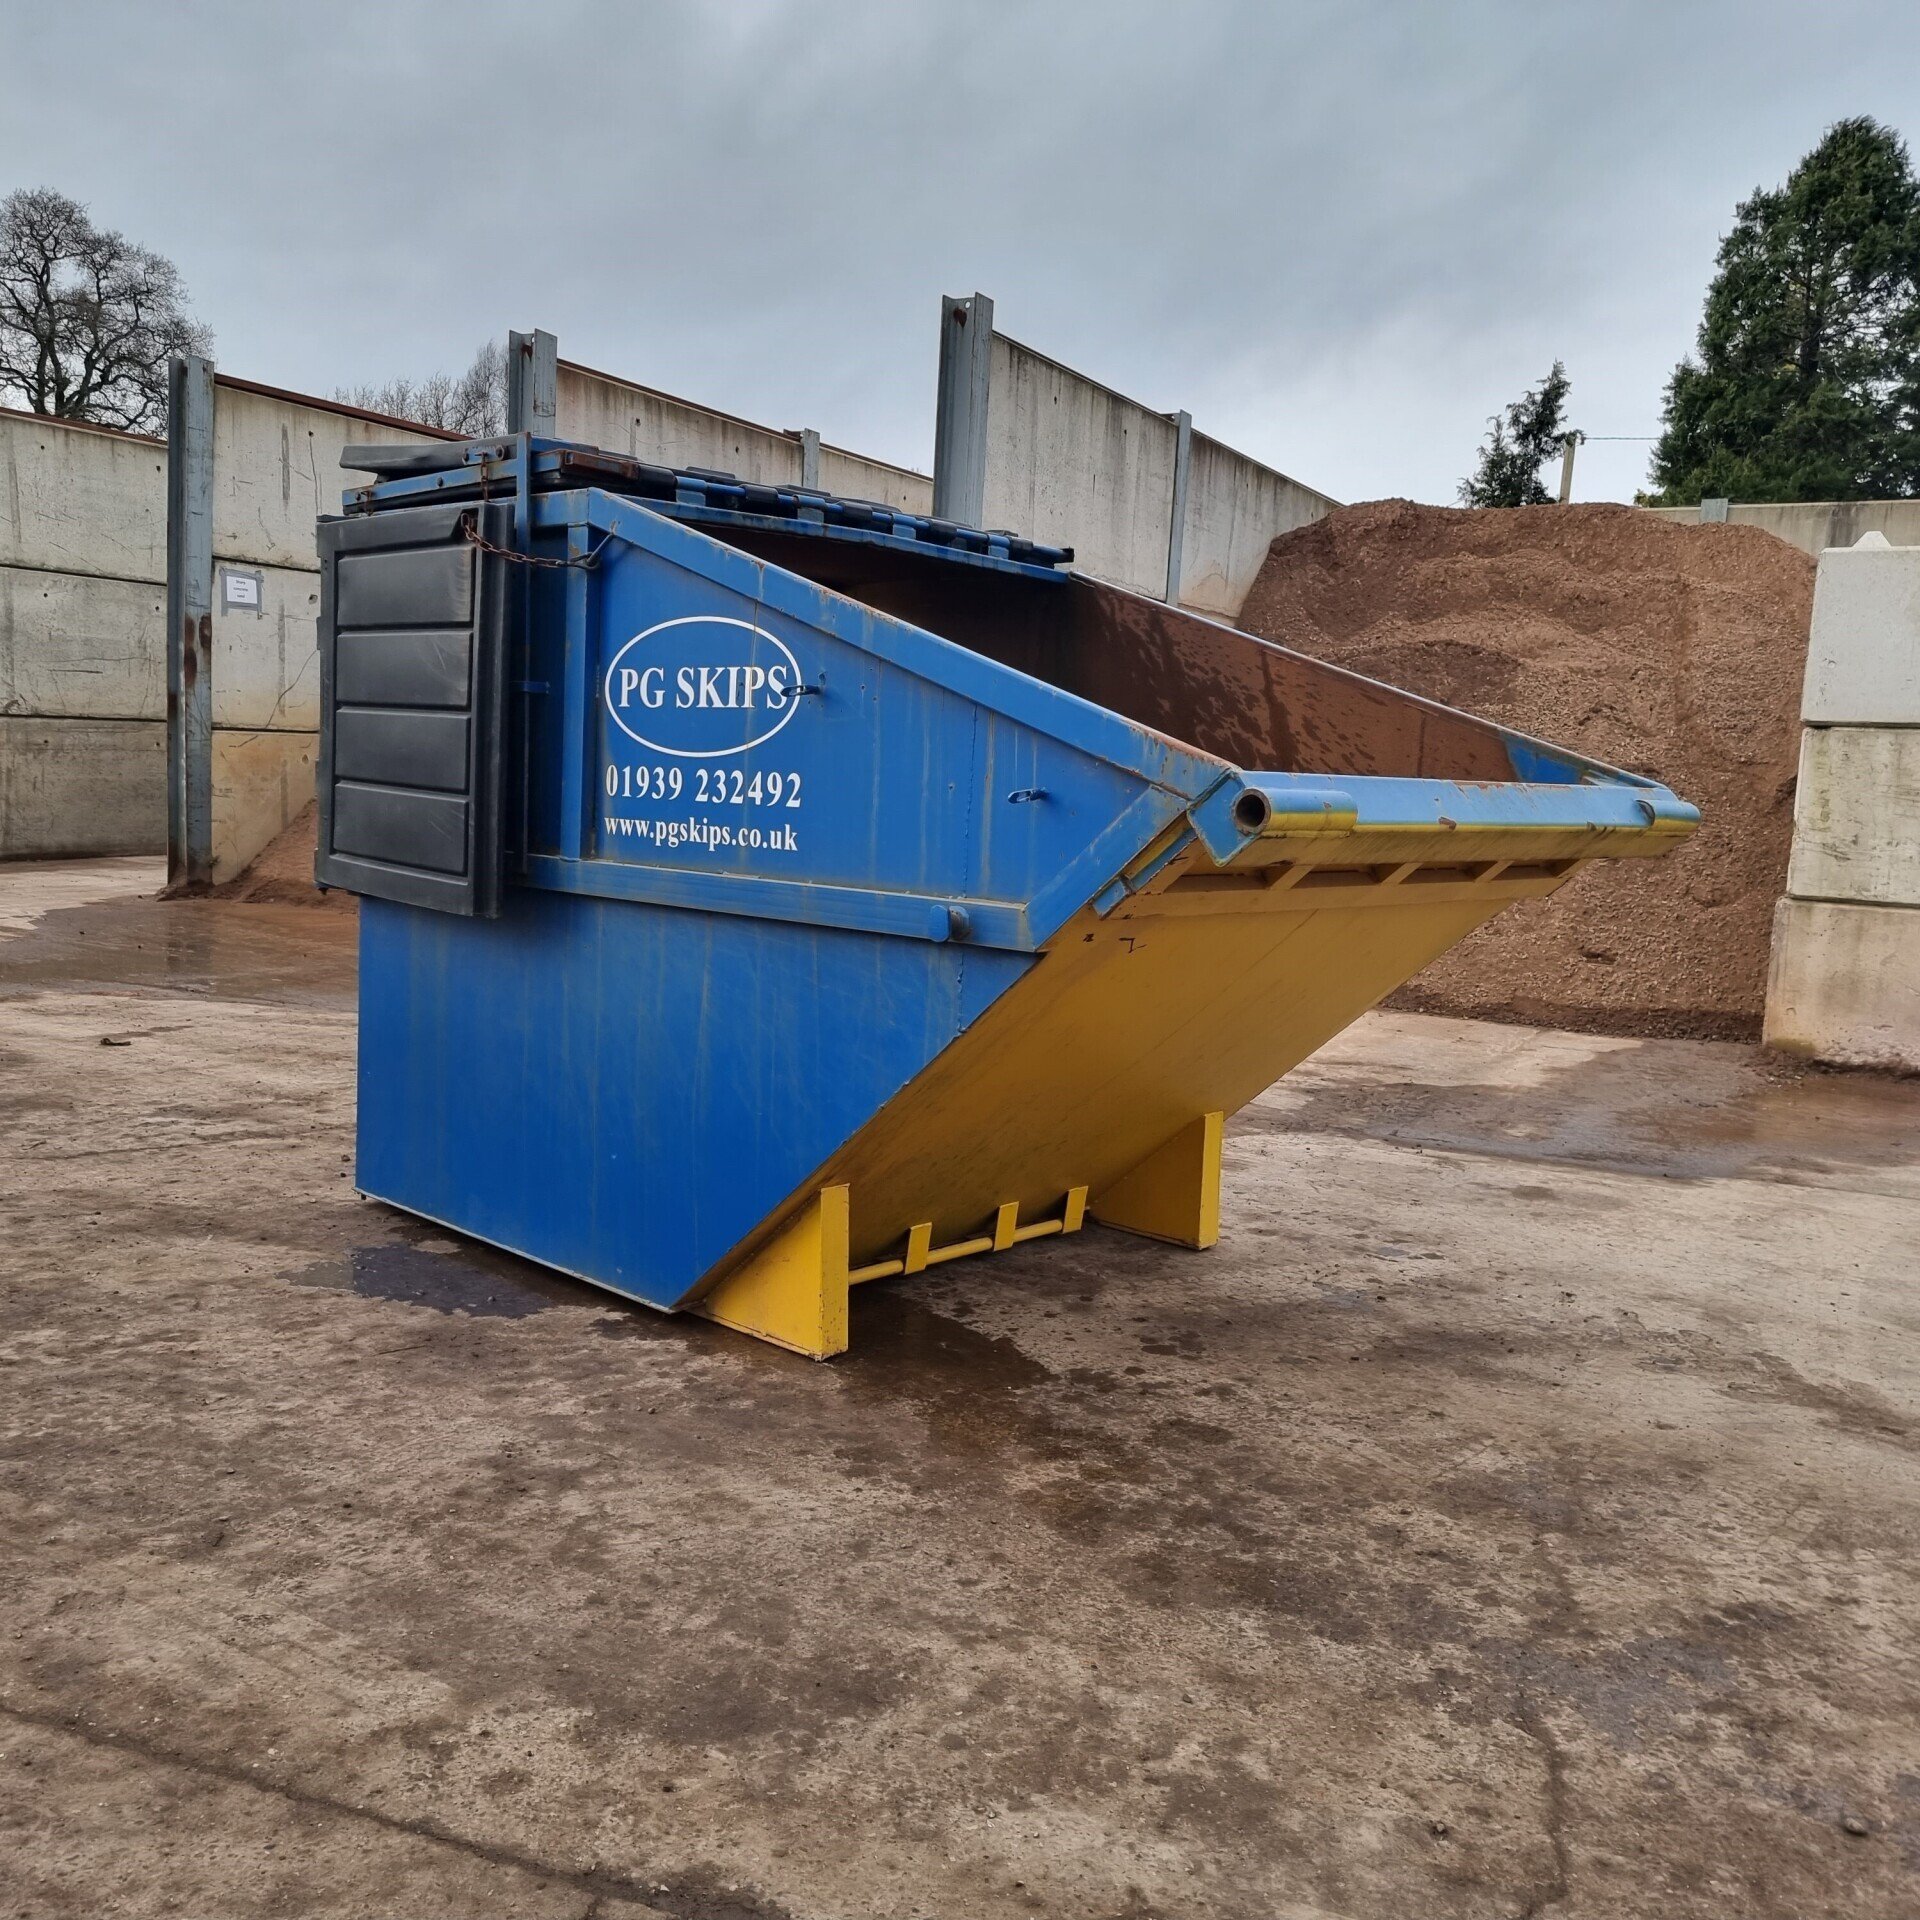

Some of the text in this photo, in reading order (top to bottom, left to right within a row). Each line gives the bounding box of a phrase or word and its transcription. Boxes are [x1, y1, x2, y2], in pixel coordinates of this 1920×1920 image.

[618, 664, 788, 710] PG SKIPS
[605, 764, 801, 808] 01939 232492
[604, 816, 798, 851] www.pgskips.co.uk
